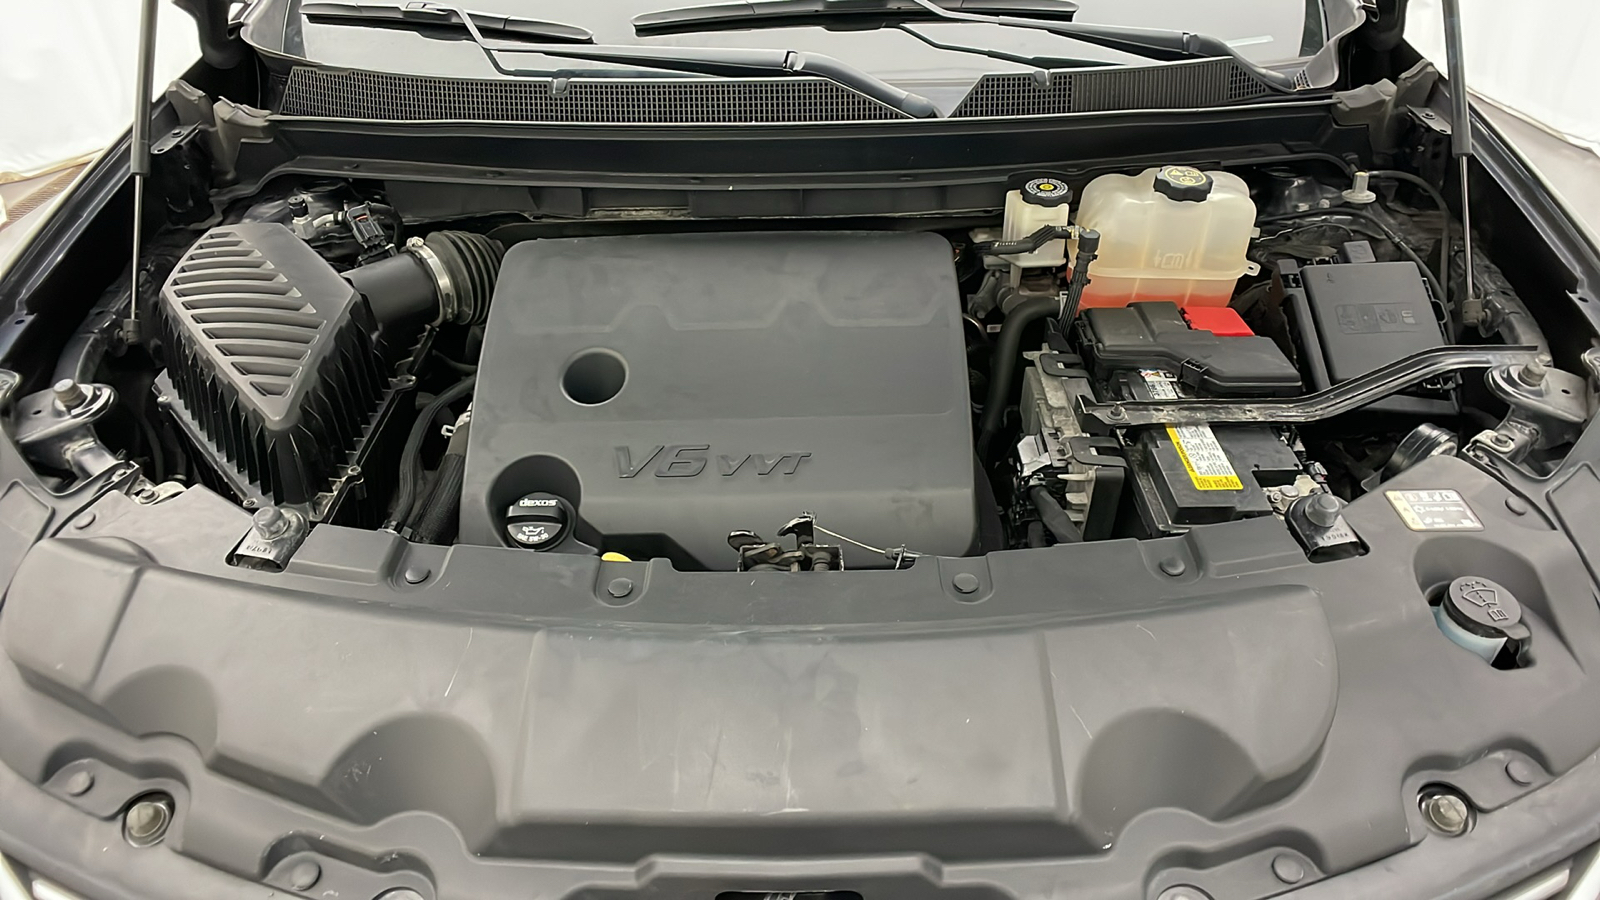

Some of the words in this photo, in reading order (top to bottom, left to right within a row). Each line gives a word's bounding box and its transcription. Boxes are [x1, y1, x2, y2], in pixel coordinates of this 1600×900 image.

[614, 444, 710, 479] V6
[716, 452, 812, 476] VVT
[519, 498, 558, 507] dexos
